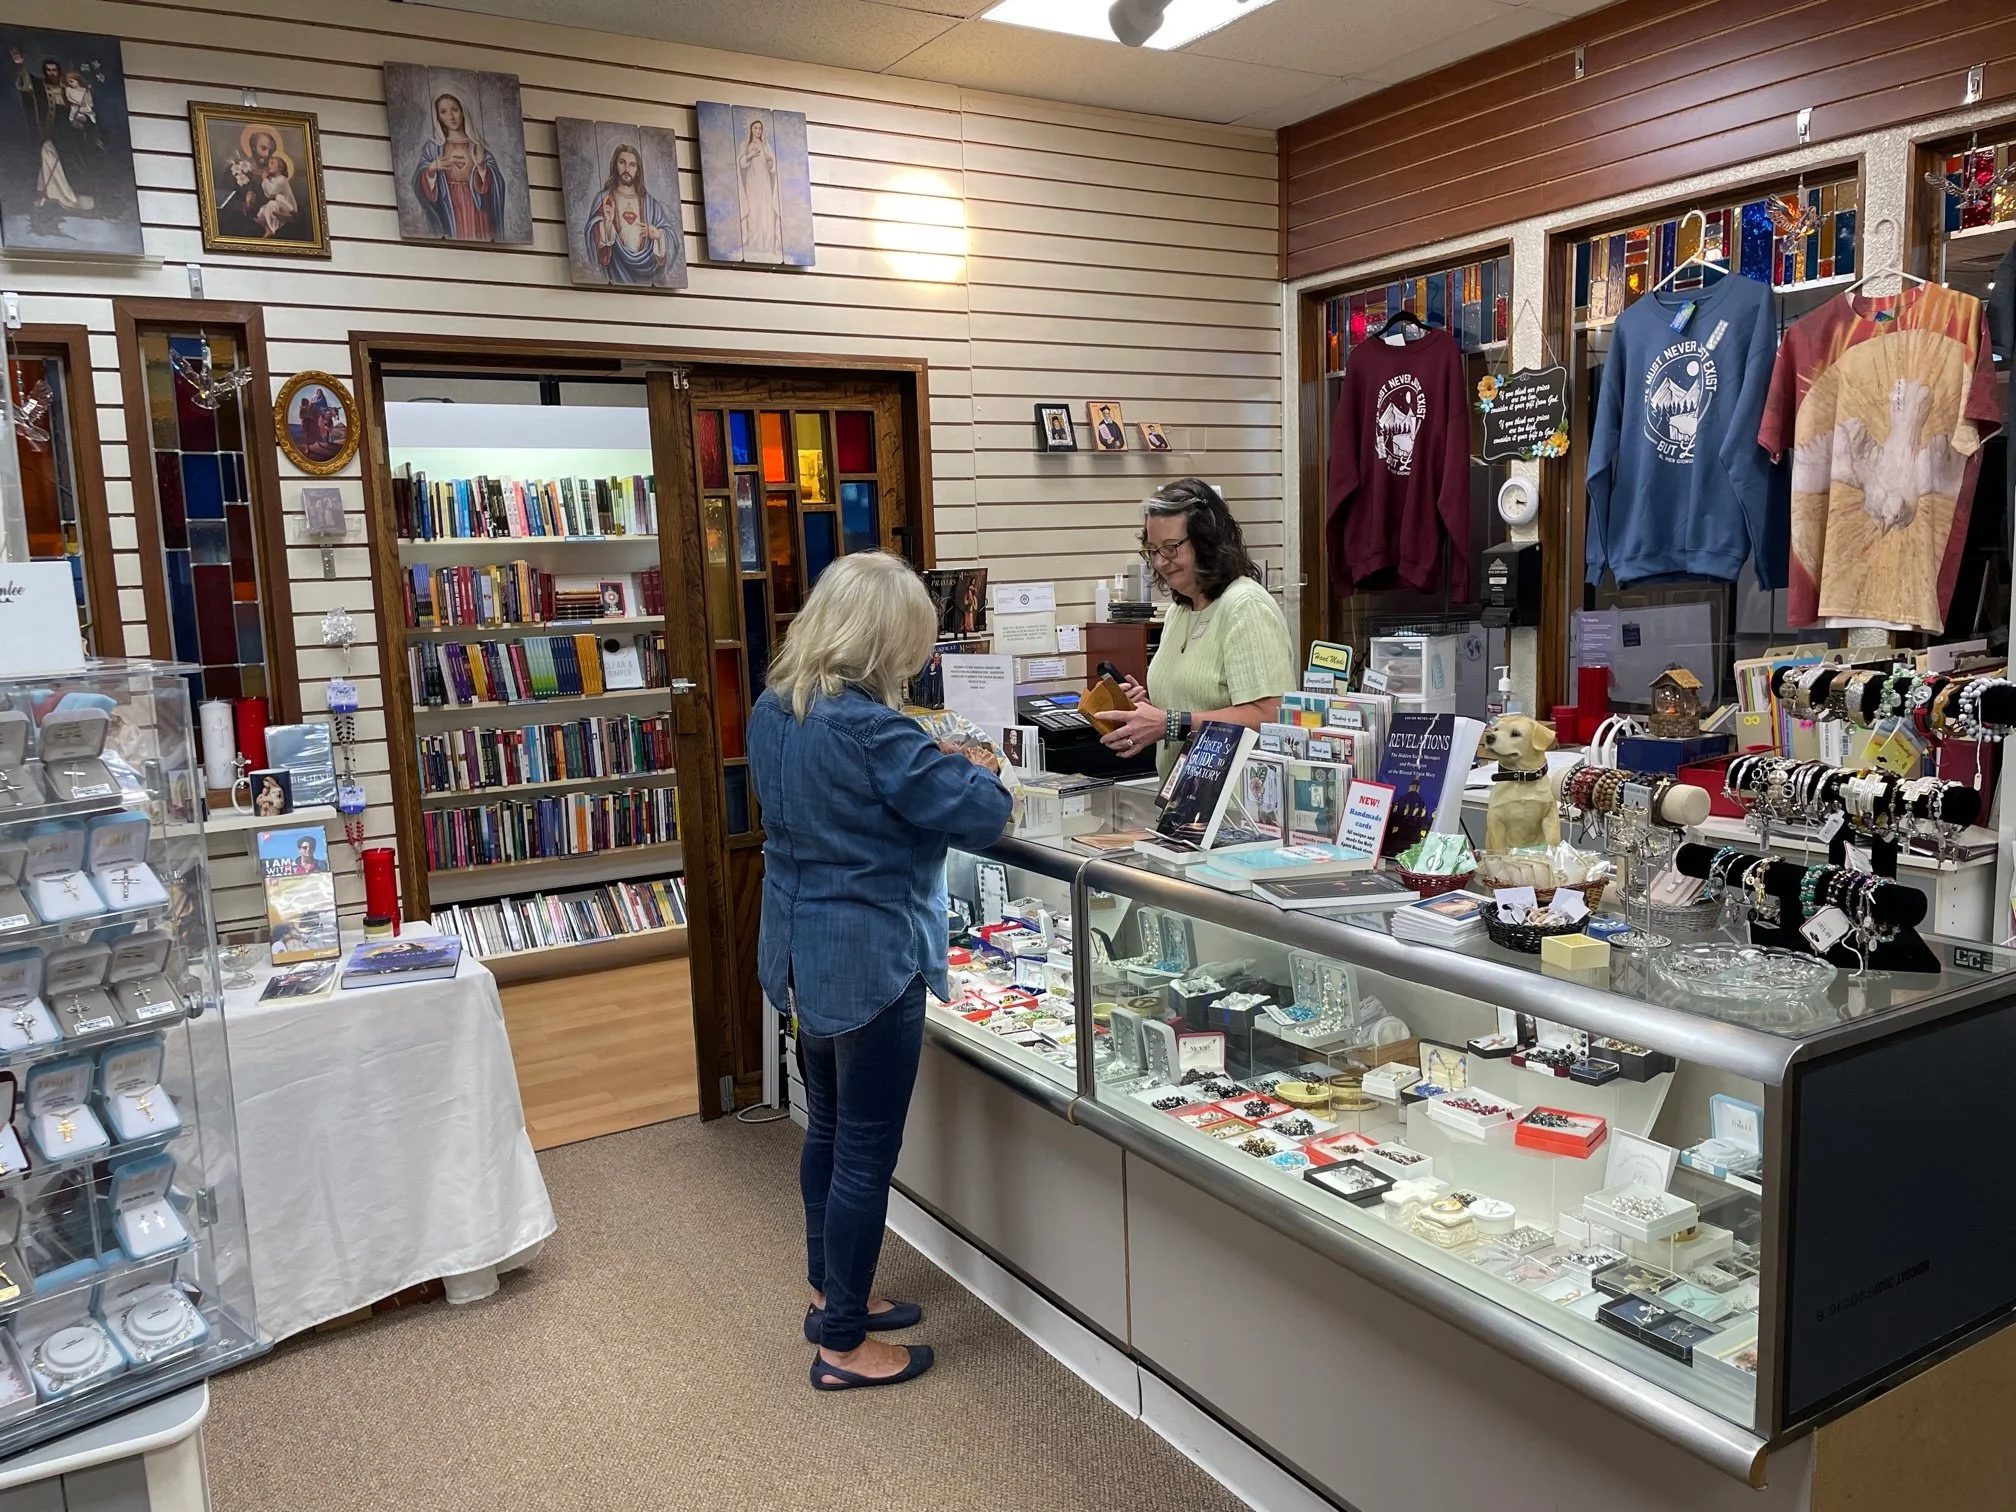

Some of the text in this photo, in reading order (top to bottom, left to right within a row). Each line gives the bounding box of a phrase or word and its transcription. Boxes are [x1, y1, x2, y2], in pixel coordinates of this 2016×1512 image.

[1645, 356, 1663, 384] MUST
[1664, 340, 1696, 360] NEVER
[1703, 360, 1717, 392] EXIST
[1388, 374, 1411, 388] NEVER
[1417, 393, 1426, 419] EXIST
[1499, 390, 1505, 401] If
[1505, 391, 1513, 402] you
[1515, 386, 1526, 395] think
[1536, 384, 1550, 394] prices
[1491, 405, 1508, 414] consider
[1515, 402, 1524, 411] your
[1526, 400, 1534, 410] gift
[1536, 398, 1546, 408] from
[1499, 419, 1505, 430] If
[1505, 420, 1513, 428] you
[1515, 416, 1526, 425] think
[1536, 414, 1550, 423] prices
[1493, 435, 1511, 444] consider
[1518, 433, 1527, 442] your
[1529, 431, 1537, 441] gift
[1657, 440, 1677, 456] BUT
[1315, 653, 1344, 665] Hand Made
[1367, 676, 1383, 686] Birthday
[1332, 714, 1346, 722] Thinking
[1389, 733, 1450, 750] REVELATIONS
[1189, 748, 1216, 768] GUIDE
[1184, 765, 1221, 781] PURGATORY
[1359, 796, 1380, 807] NEW!
[1350, 808, 1382, 822] Handmade
[1355, 821, 1372, 830] cards
[1293, 834, 1316, 842] Handmade
[1341, 841, 1351, 849] Spirit
[265, 859, 291, 868] I AM
[266, 866, 292, 875] WITH
